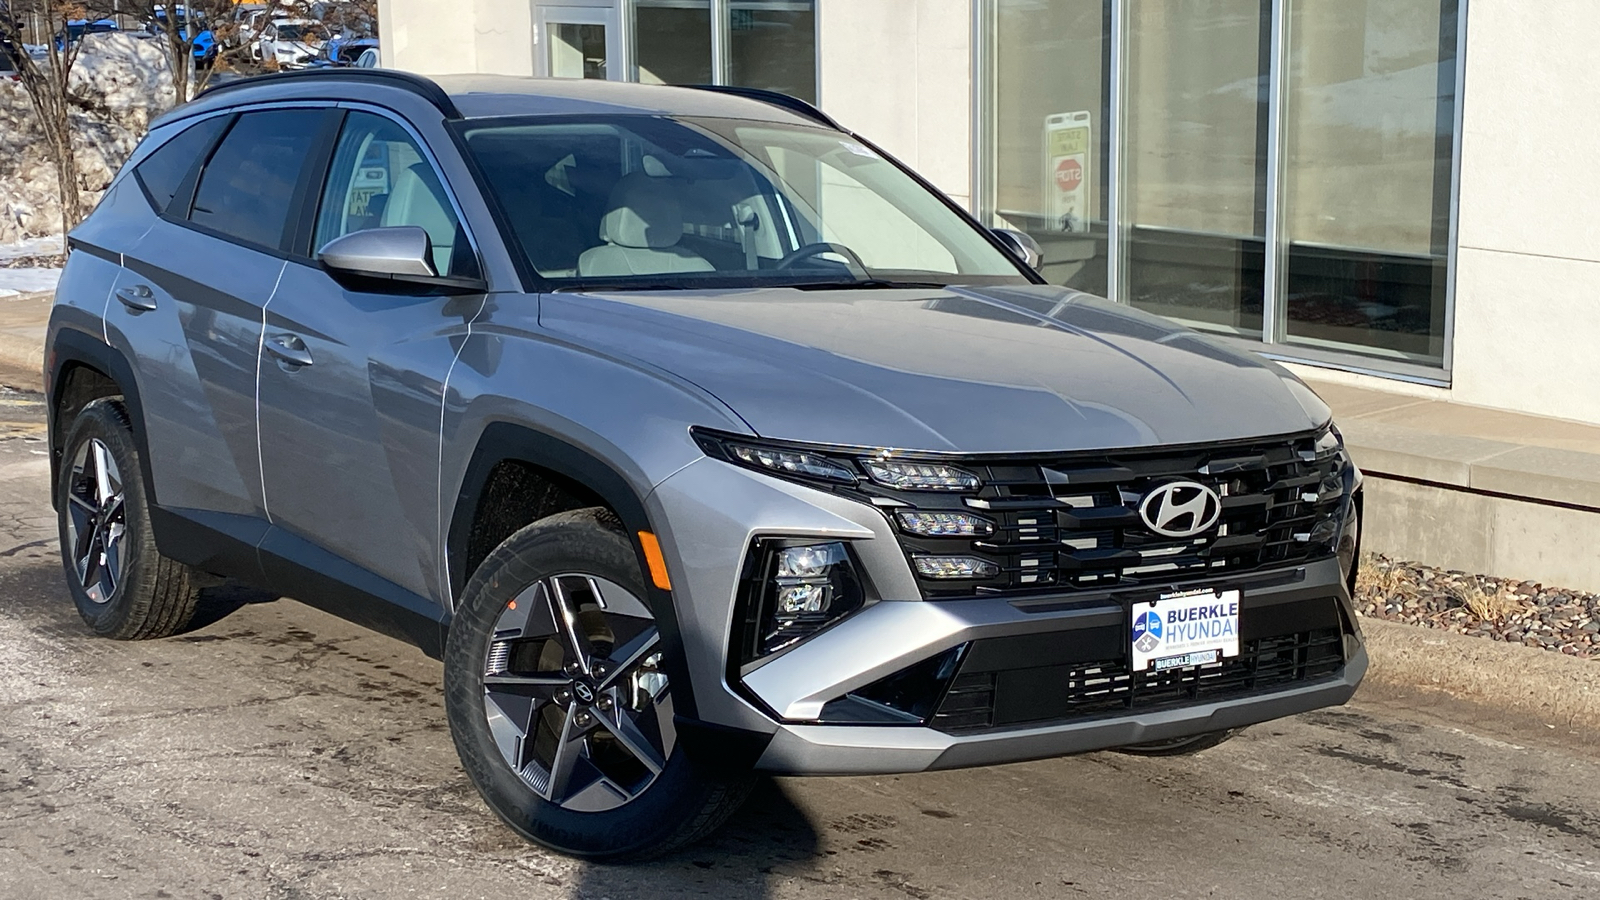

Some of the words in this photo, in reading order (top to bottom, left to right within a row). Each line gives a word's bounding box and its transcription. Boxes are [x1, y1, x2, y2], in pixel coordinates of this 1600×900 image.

[1167, 603, 1238, 624] BUERKLE
[1166, 618, 1238, 644] HYUNDAI
[1156, 655, 1190, 669] BUERKLE
[1190, 652, 1216, 664] HYUNDAI
